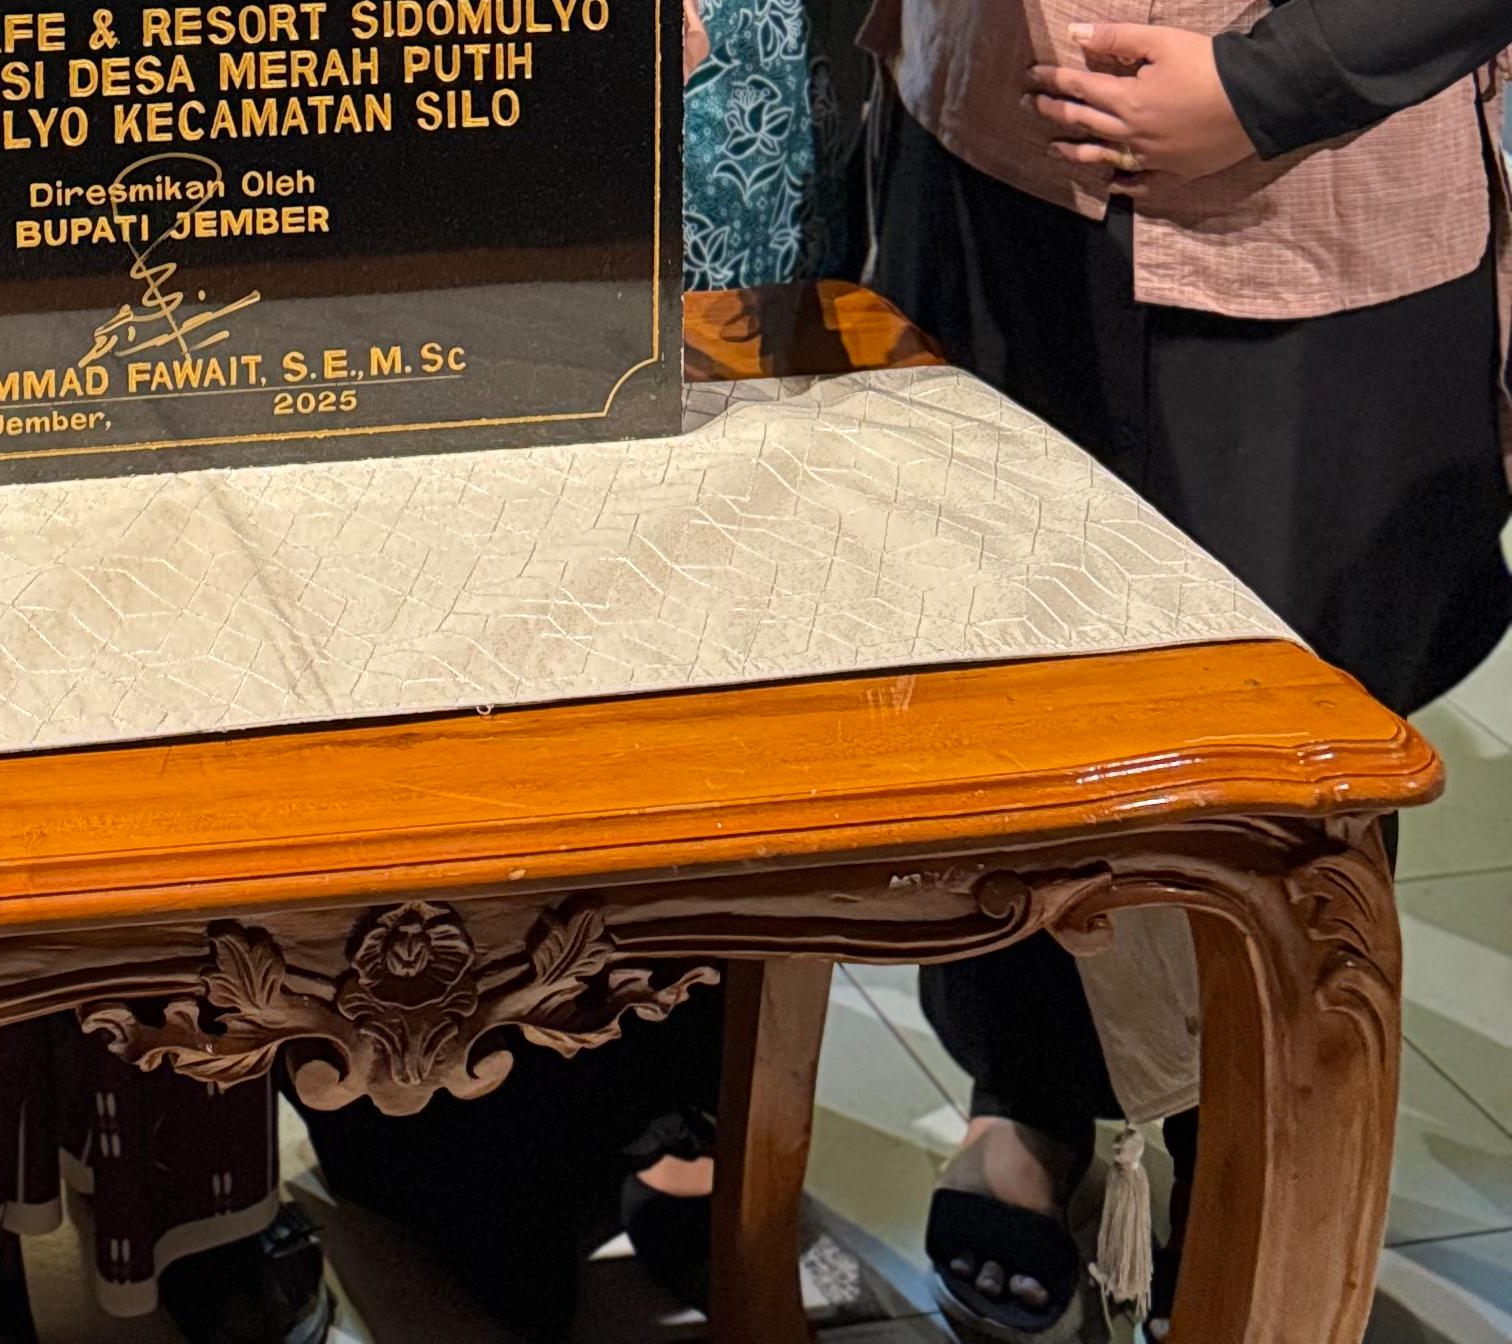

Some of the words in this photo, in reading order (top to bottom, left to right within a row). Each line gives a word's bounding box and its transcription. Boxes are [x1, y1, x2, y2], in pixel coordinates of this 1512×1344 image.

[89, 9, 119, 50] &
[143, 3, 326, 47] RESORT
[69, 55, 195, 97] DESA
[220, 48, 378, 91] MERAH
[404, 42, 532, 83] PUTIH
[114, 94, 391, 143] KECAMATAN
[416, 88, 520, 130] SILO
[30, 174, 226, 208] Diresmikan
[242, 171, 314, 197] Oleh
[16, 213, 148, 248] BUPATI
[167, 206, 328, 239] JEMBER
[126, 354, 267, 390] FAWAIT,
[272, 387, 358, 417] 2025
